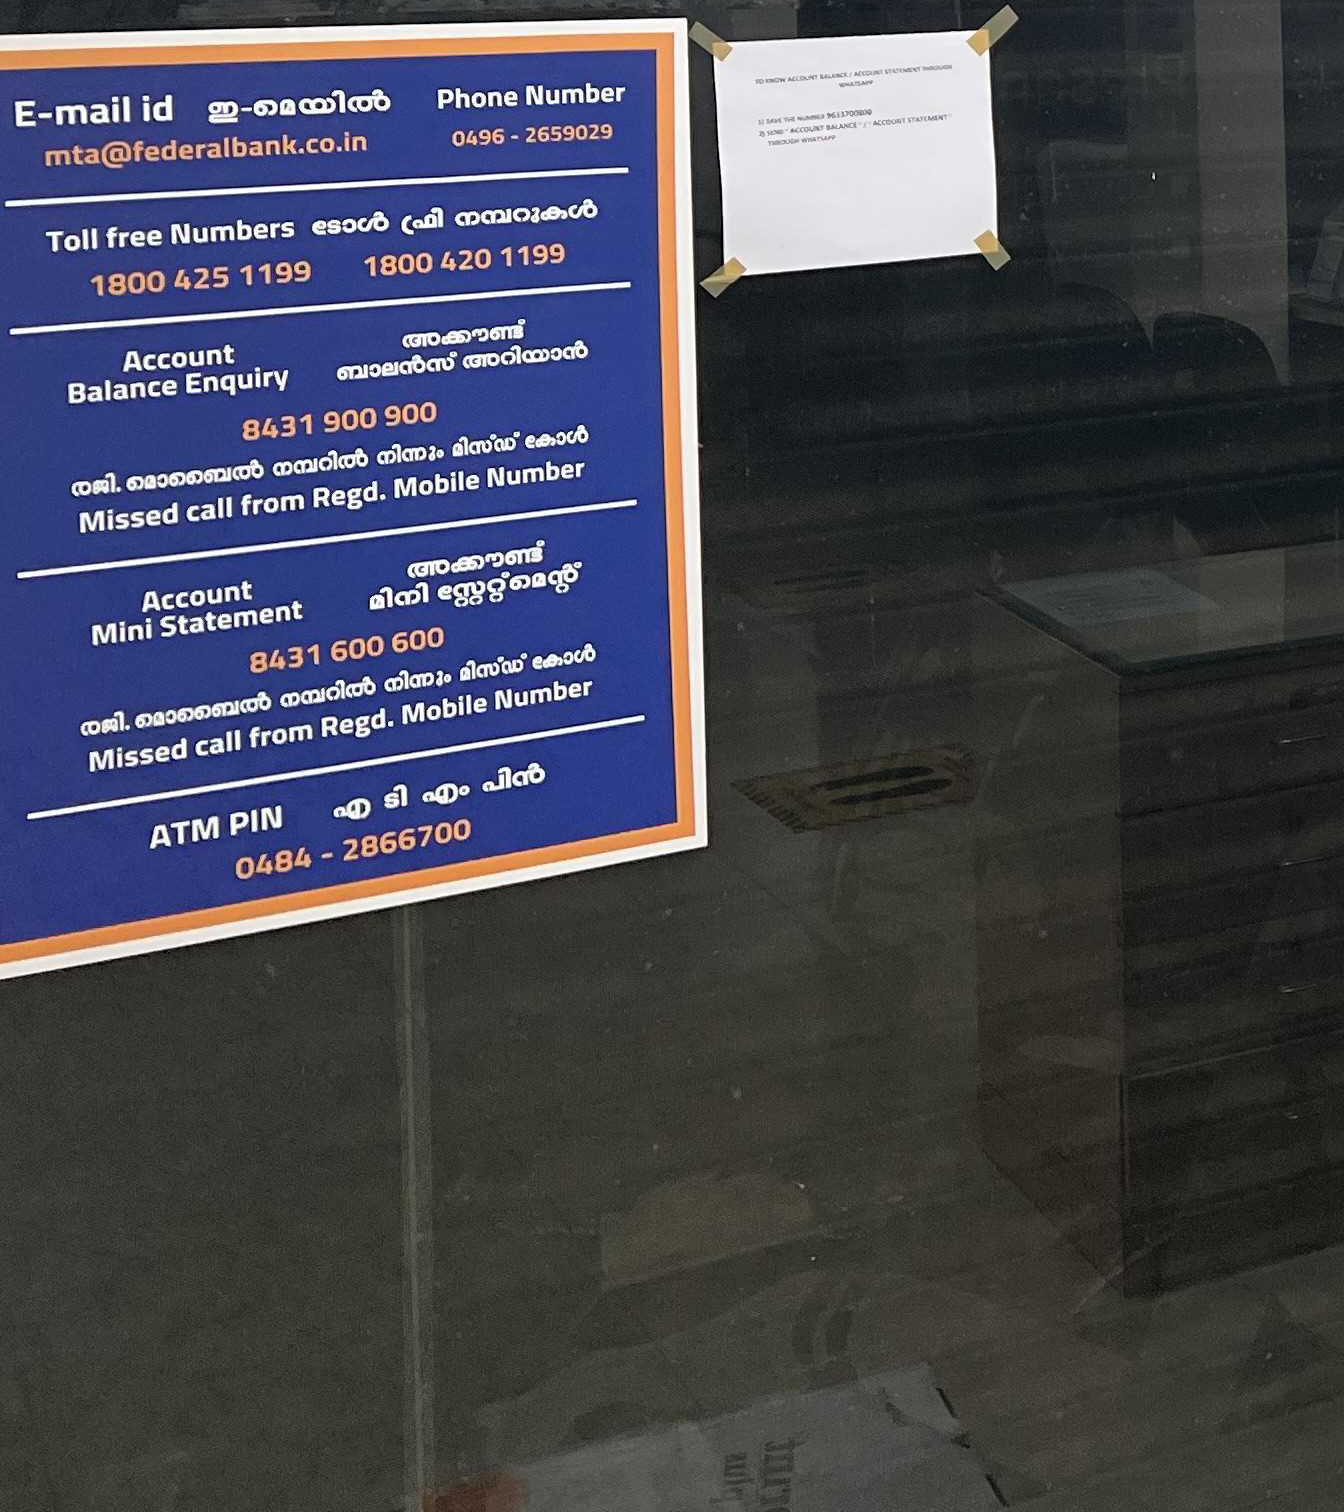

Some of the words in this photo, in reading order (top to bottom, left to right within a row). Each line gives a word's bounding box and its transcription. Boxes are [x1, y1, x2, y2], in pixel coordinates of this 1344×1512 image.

[787, 74, 818, 83] ACCOUNT
[819, 72, 848, 80] BALANCE
[854, 69, 884, 78] ACCOUNT
[885, 66, 921, 76] STATEMENT
[14, 95, 131, 127] E-mail
[142, 94, 173, 122] id
[207, 88, 391, 124] ഇ-മെയിൽ
[437, 87, 519, 110] Phone
[525, 82, 626, 106] Number
[45, 131, 368, 169] mta@federalbank.co.in
[451, 128, 505, 147] 0496
[525, 123, 613, 143] 2659029
[45, 227, 98, 253] Toll
[105, 226, 163, 249] free
[170, 219, 295, 245] Numbers
[311, 210, 390, 236] ടോൾ
[454, 198, 598, 227] നമ്പറുകൾ
[90, 270, 166, 297] 1800
[174, 266, 230, 291] 425
[239, 260, 312, 286] 1199
[364, 252, 433, 277] 1800
[440, 248, 492, 272] 420
[500, 243, 566, 267] 1199
[122, 344, 235, 373] Account
[336, 351, 458, 381] ബാലൻസ്
[462, 339, 589, 369] അറിയാൻ
[67, 379, 178, 404] Balance
[185, 366, 289, 396] Enquiry
[242, 413, 313, 441] 8431
[323, 407, 378, 433] 900
[384, 401, 437, 427] 900
[272, 447, 369, 477] നമ്പറിൽ
[376, 443, 445, 465] നിന്നും
[524, 424, 589, 449] കോൾ
[79, 502, 179, 534] Missed
[186, 496, 233, 522] call
[240, 493, 305, 516] from
[313, 480, 387, 510] Regd.
[393, 470, 480, 499] Mobile
[487, 460, 585, 488] Number
[141, 580, 253, 613] Account
[369, 581, 430, 610] മിനി
[91, 617, 153, 646] Mini
[159, 597, 304, 638] Statement
[249, 643, 320, 674] 8431
[330, 635, 385, 662] 600
[391, 627, 445, 653] 600
[279, 676, 377, 708] നമ്പറിൽ
[383, 669, 452, 692] നിന്നും
[531, 643, 597, 670] കോൾ
[89, 737, 188, 773] Missed
[195, 729, 241, 756] call
[249, 724, 313, 748] from
[321, 707, 394, 738] Regd.
[401, 694, 488, 725] Mobile
[494, 680, 593, 710] Number
[333, 797, 372, 820] എ
[383, 784, 408, 809] ടി
[421, 783, 471, 805] എം
[481, 762, 546, 793] പിൻ
[149, 815, 220, 850] ATM
[229, 805, 283, 836] PIN
[235, 847, 312, 880] 0484
[343, 818, 472, 861] 2866700
